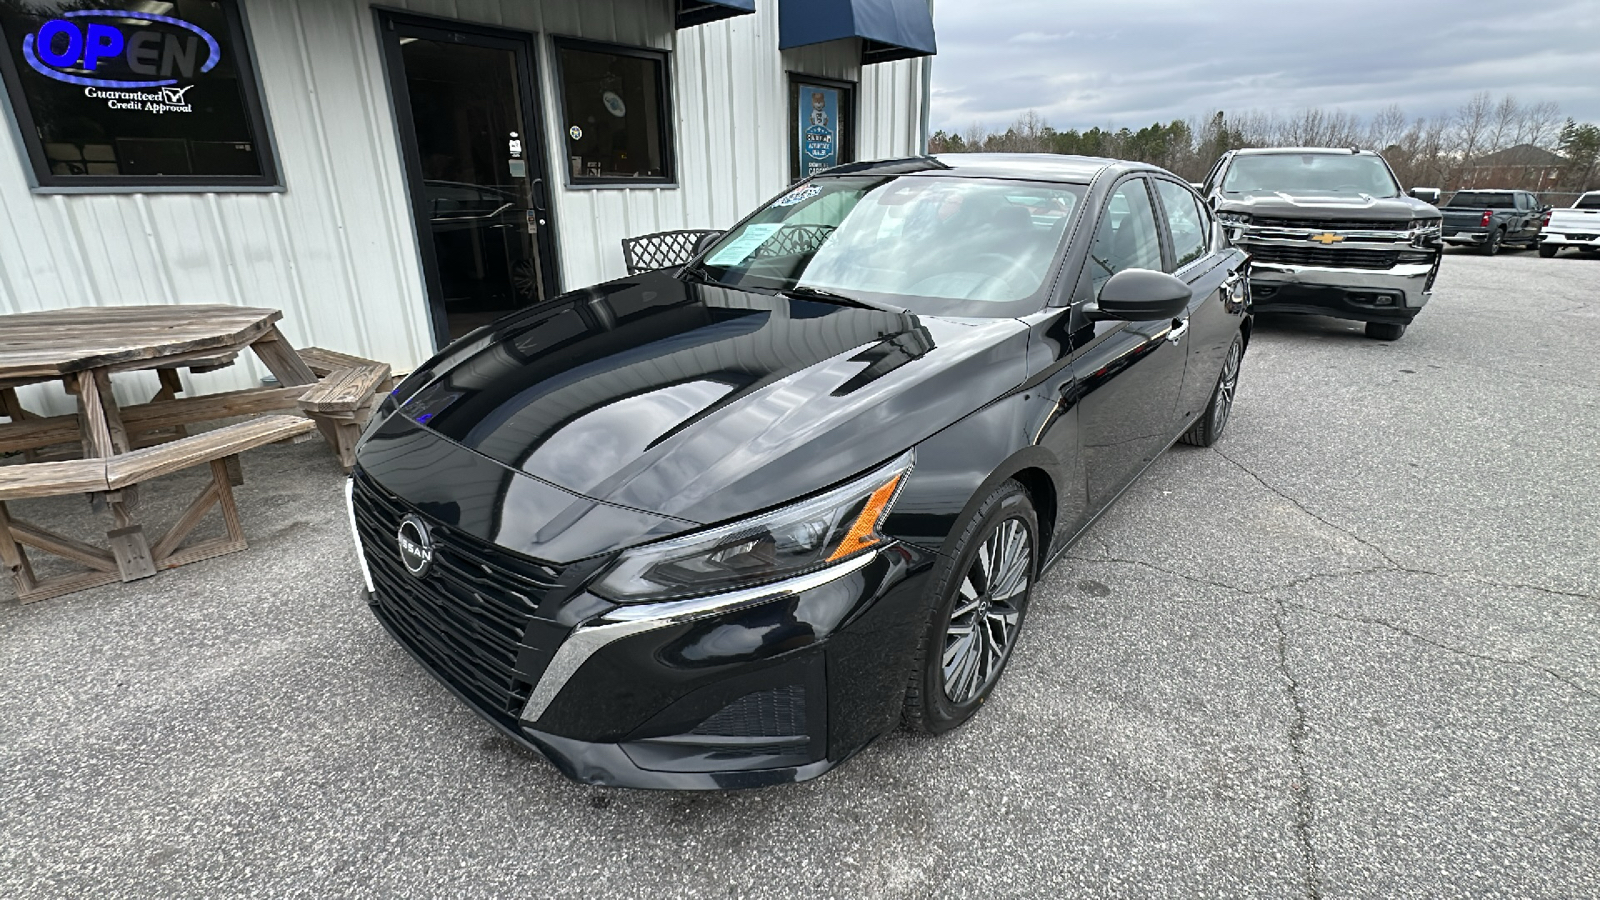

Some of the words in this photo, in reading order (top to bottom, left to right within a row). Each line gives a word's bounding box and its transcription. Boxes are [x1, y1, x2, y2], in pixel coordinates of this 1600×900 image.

[37, 19, 198, 78] OPEN
[84, 86, 163, 101] Guaranteed
[107, 99, 142, 110] Credit
[144, 101, 192, 114] Approval
[399, 537, 431, 561] SSAN
